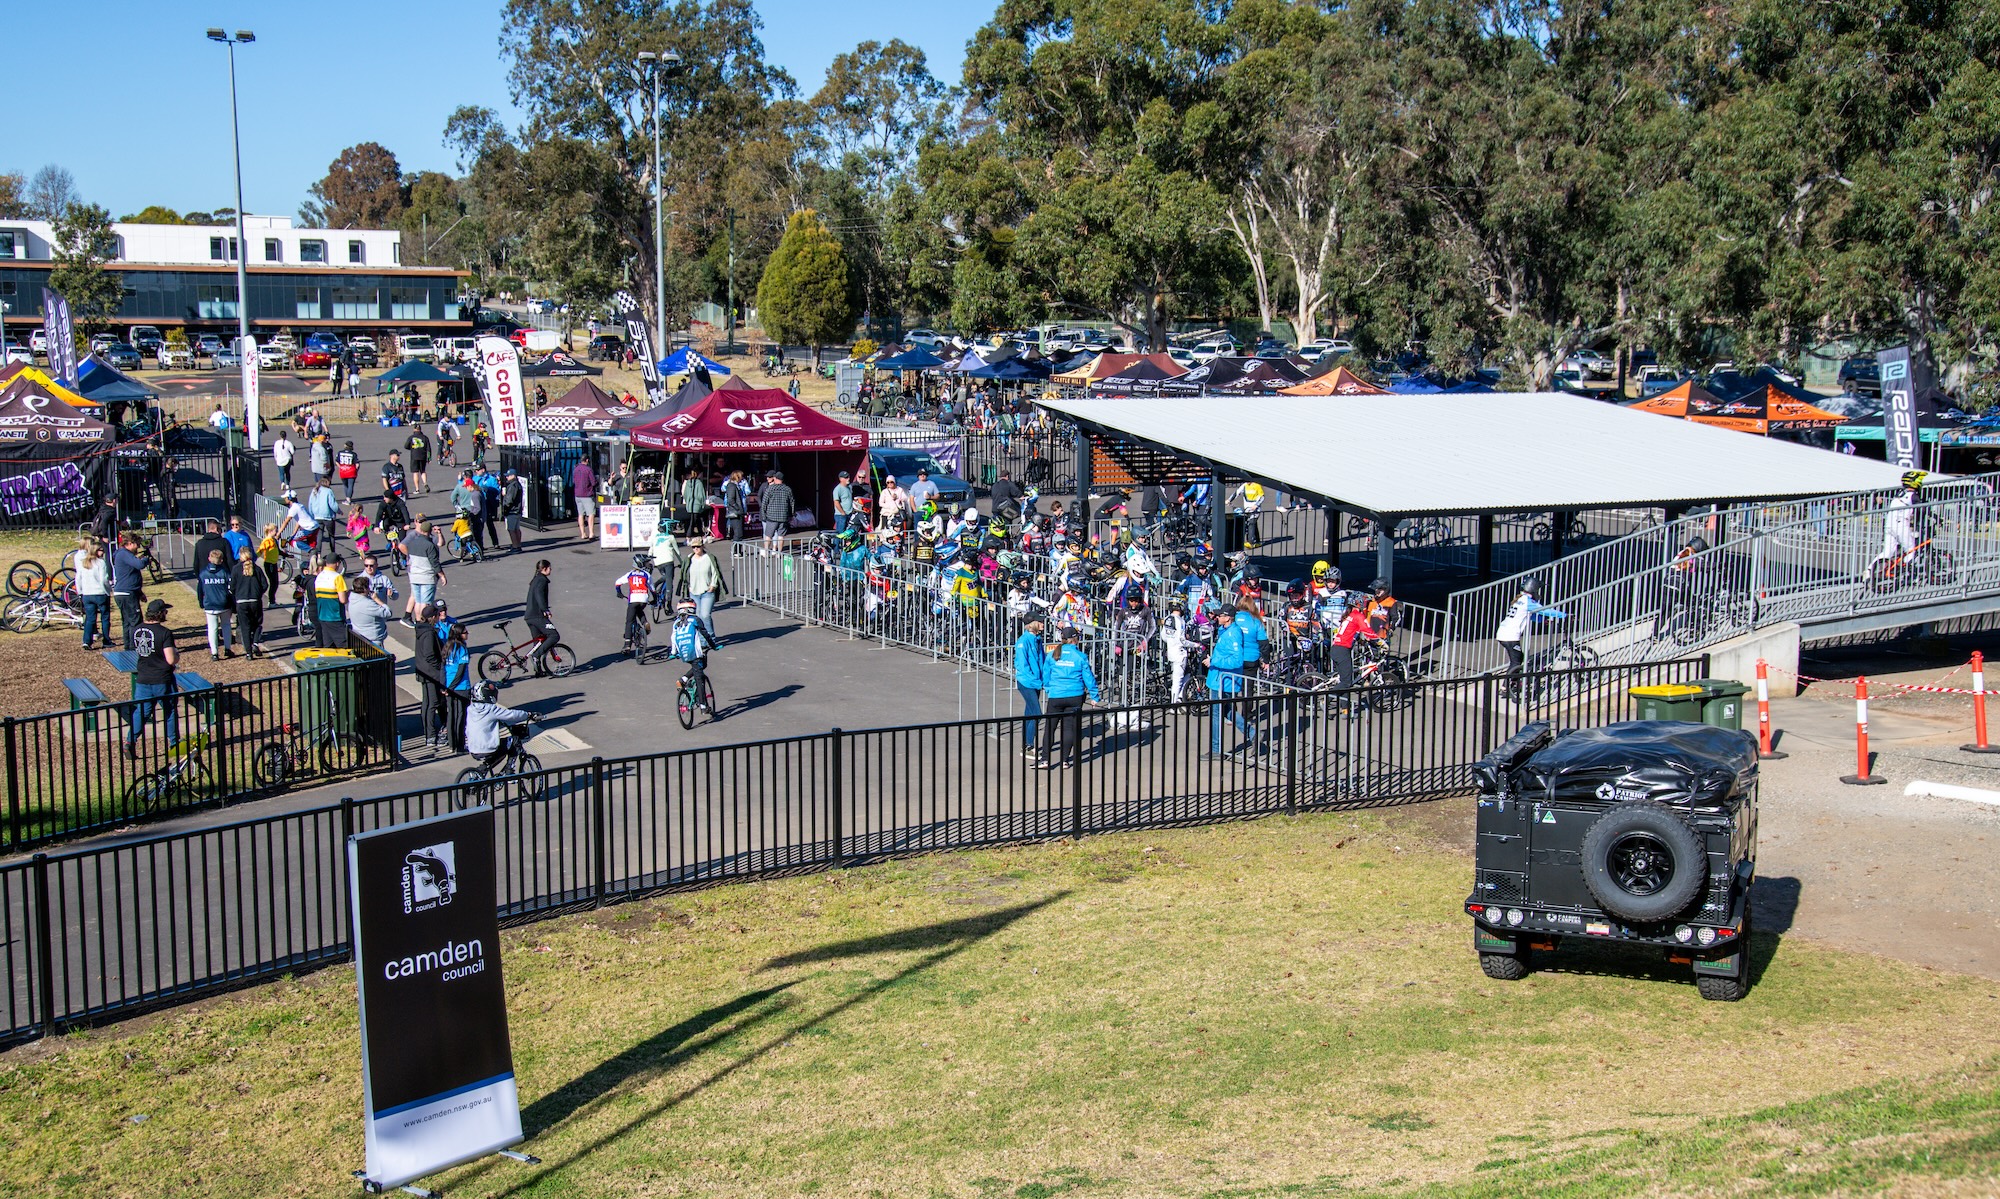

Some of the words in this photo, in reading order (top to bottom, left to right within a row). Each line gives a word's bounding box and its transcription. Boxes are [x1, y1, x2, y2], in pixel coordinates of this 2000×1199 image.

[486, 351, 516, 366] CAFE
[1053, 376, 1071, 384] CASTLE
[496, 369, 518, 443] COFFEE
[583, 419, 614, 429] ace
[726, 410, 800, 431] CAFE
[680, 437, 703, 448] CAFE
[840, 434, 863, 447] CAFE
[1958, 435, 1971, 444] WE
[1973, 435, 1994, 445] RIDE
[339, 456, 353, 465] 997
[48, 496, 95, 517] CYCLES
[1616, 788, 1647, 800] PATRIOT
[401, 866, 412, 915] camden
[415, 901, 437, 913] council
[384, 938, 483, 980] camden
[1700, 961, 1732, 969] CAMPERS
[442, 959, 485, 982] council
[403, 1095, 493, 1128] www.camden.nsw.gov.au
